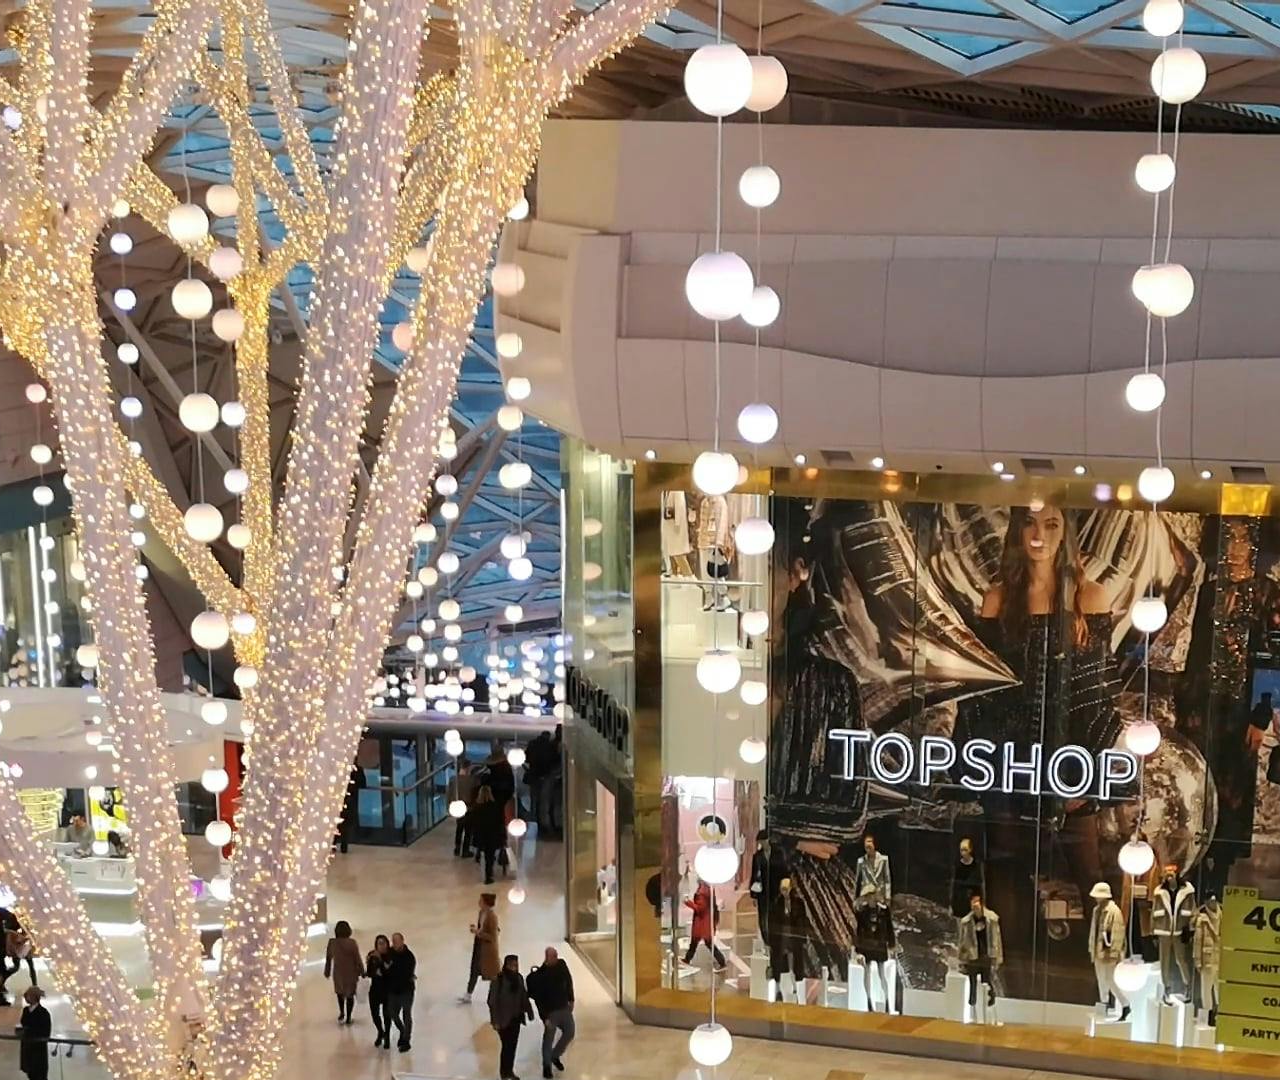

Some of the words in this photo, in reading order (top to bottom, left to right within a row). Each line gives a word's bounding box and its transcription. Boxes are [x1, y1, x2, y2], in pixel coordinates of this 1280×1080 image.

[828, 728, 1138, 800] TOPSHOP
[1225, 888, 1240, 897] UP
[1243, 889, 1256, 898] TO
